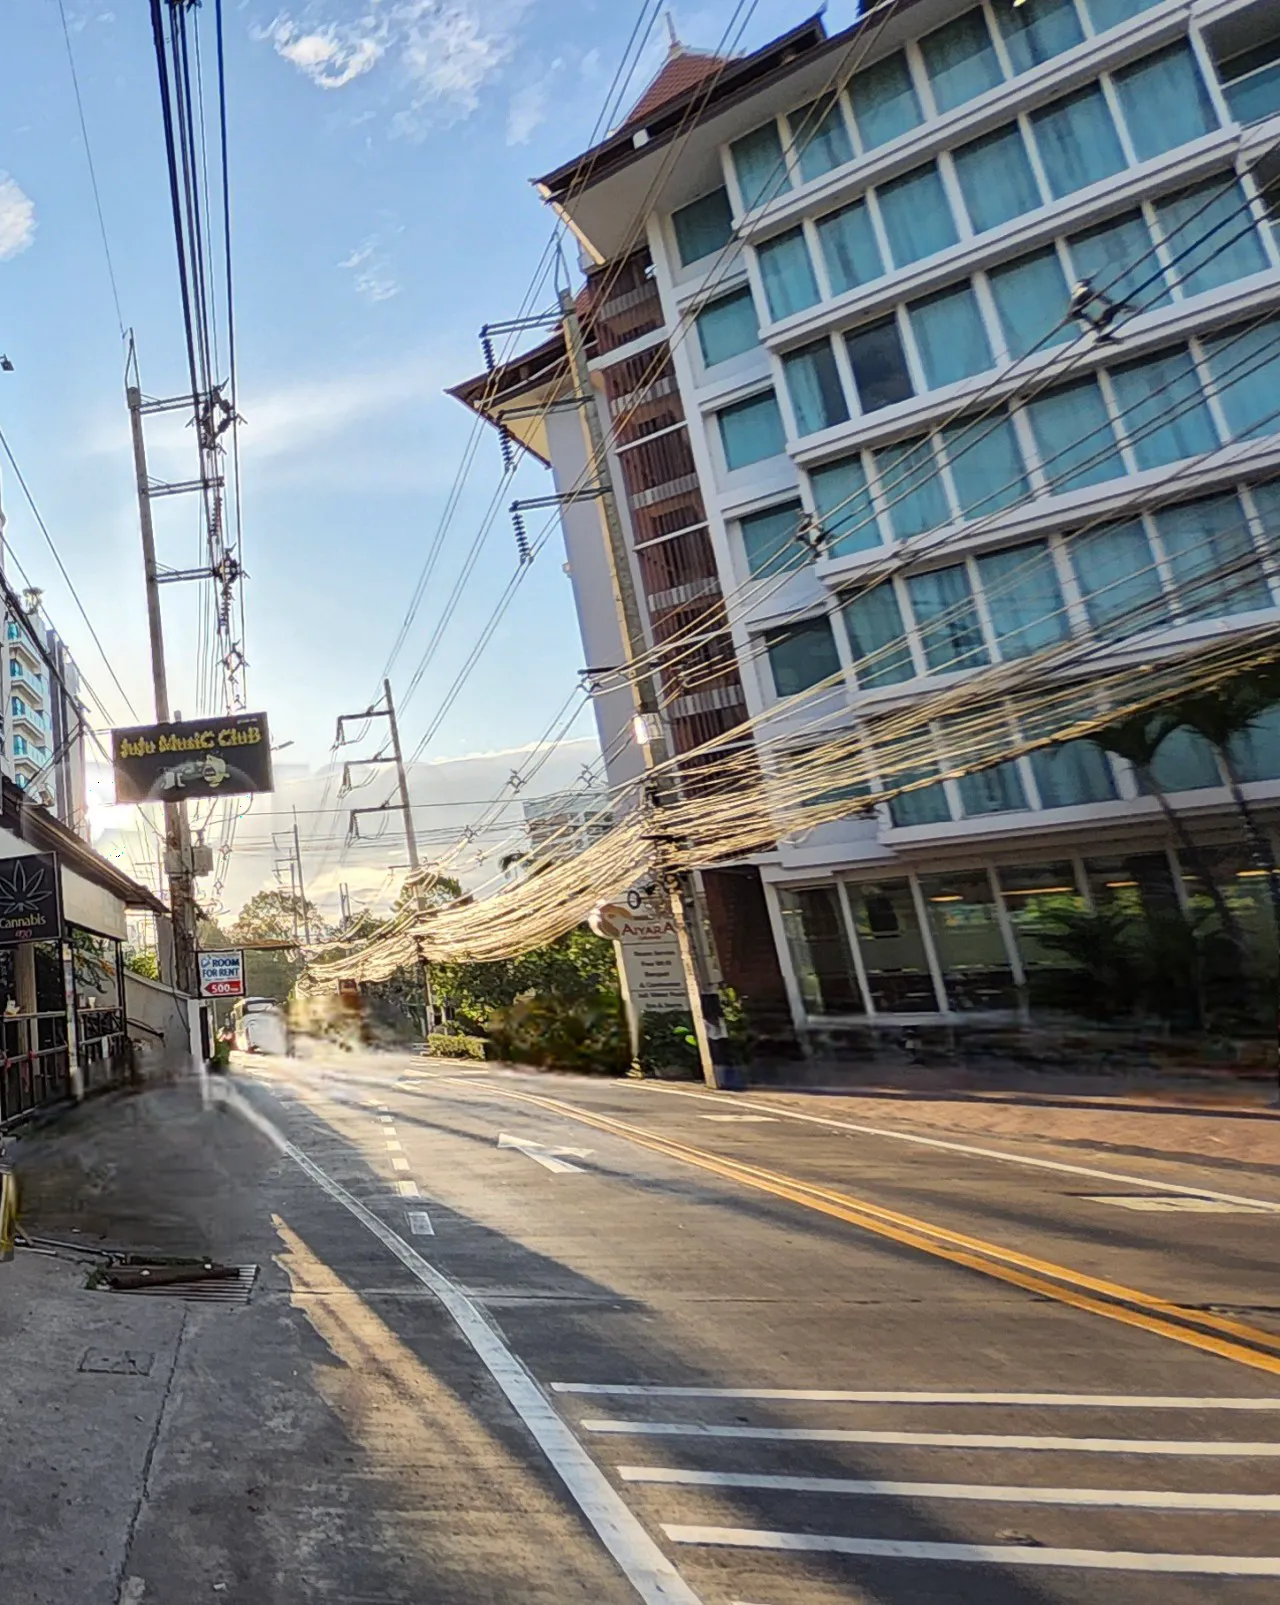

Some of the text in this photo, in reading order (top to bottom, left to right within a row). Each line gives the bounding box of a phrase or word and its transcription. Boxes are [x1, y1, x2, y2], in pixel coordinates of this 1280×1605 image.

[212, 958, 240, 968] ROOM
[202, 967, 239, 978] FOR RENT
[211, 983, 231, 994] 500
